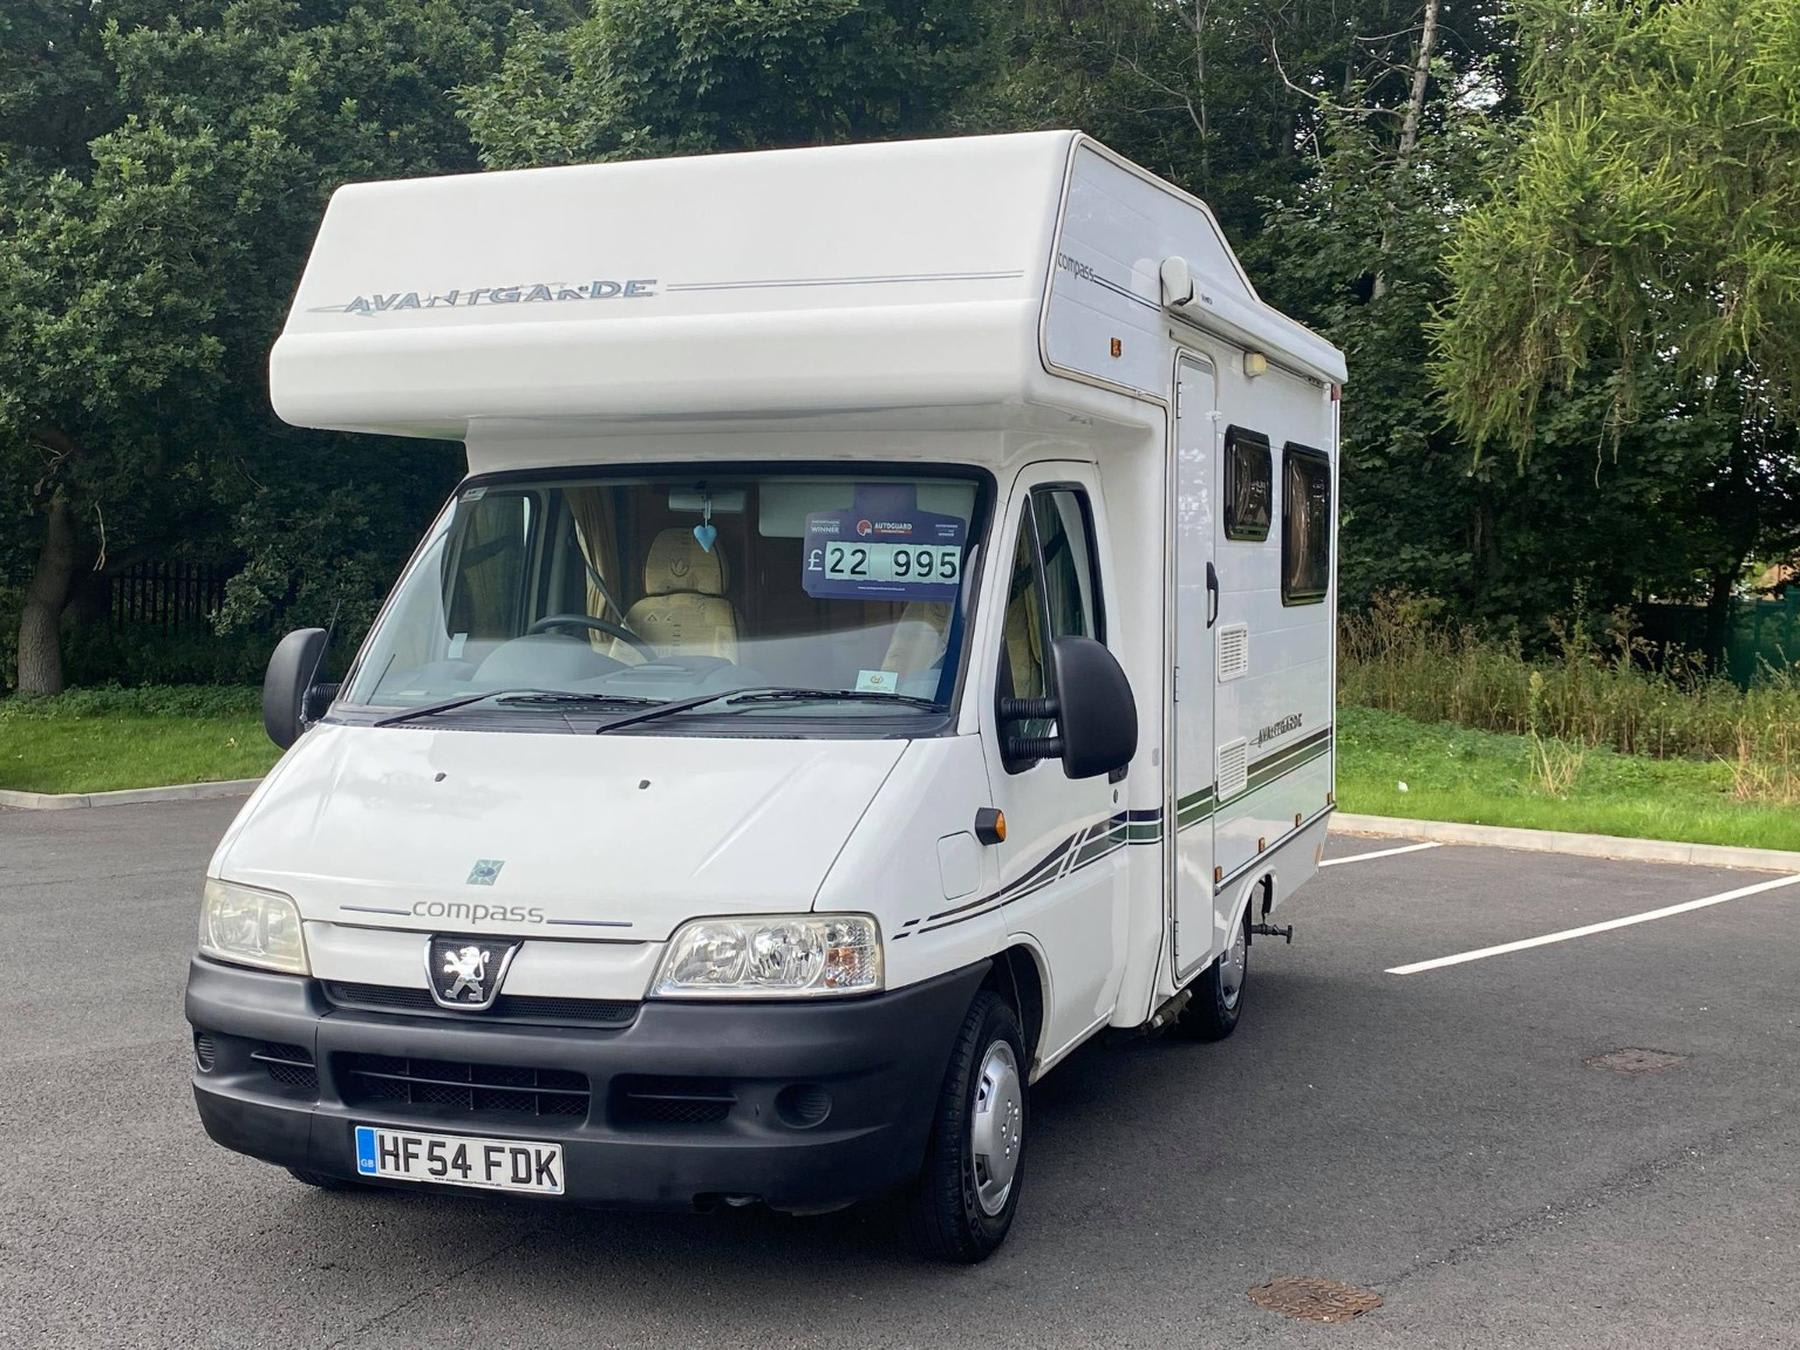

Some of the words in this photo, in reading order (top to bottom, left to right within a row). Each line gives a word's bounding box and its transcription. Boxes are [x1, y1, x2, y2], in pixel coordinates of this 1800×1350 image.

[811, 526, 840, 534] WINNER
[893, 550, 957, 579] 995
[411, 900, 545, 925] compass
[360, 1158, 375, 1169] GB
[378, 1134, 472, 1179] HF54
[483, 1145, 558, 1187] FDK
